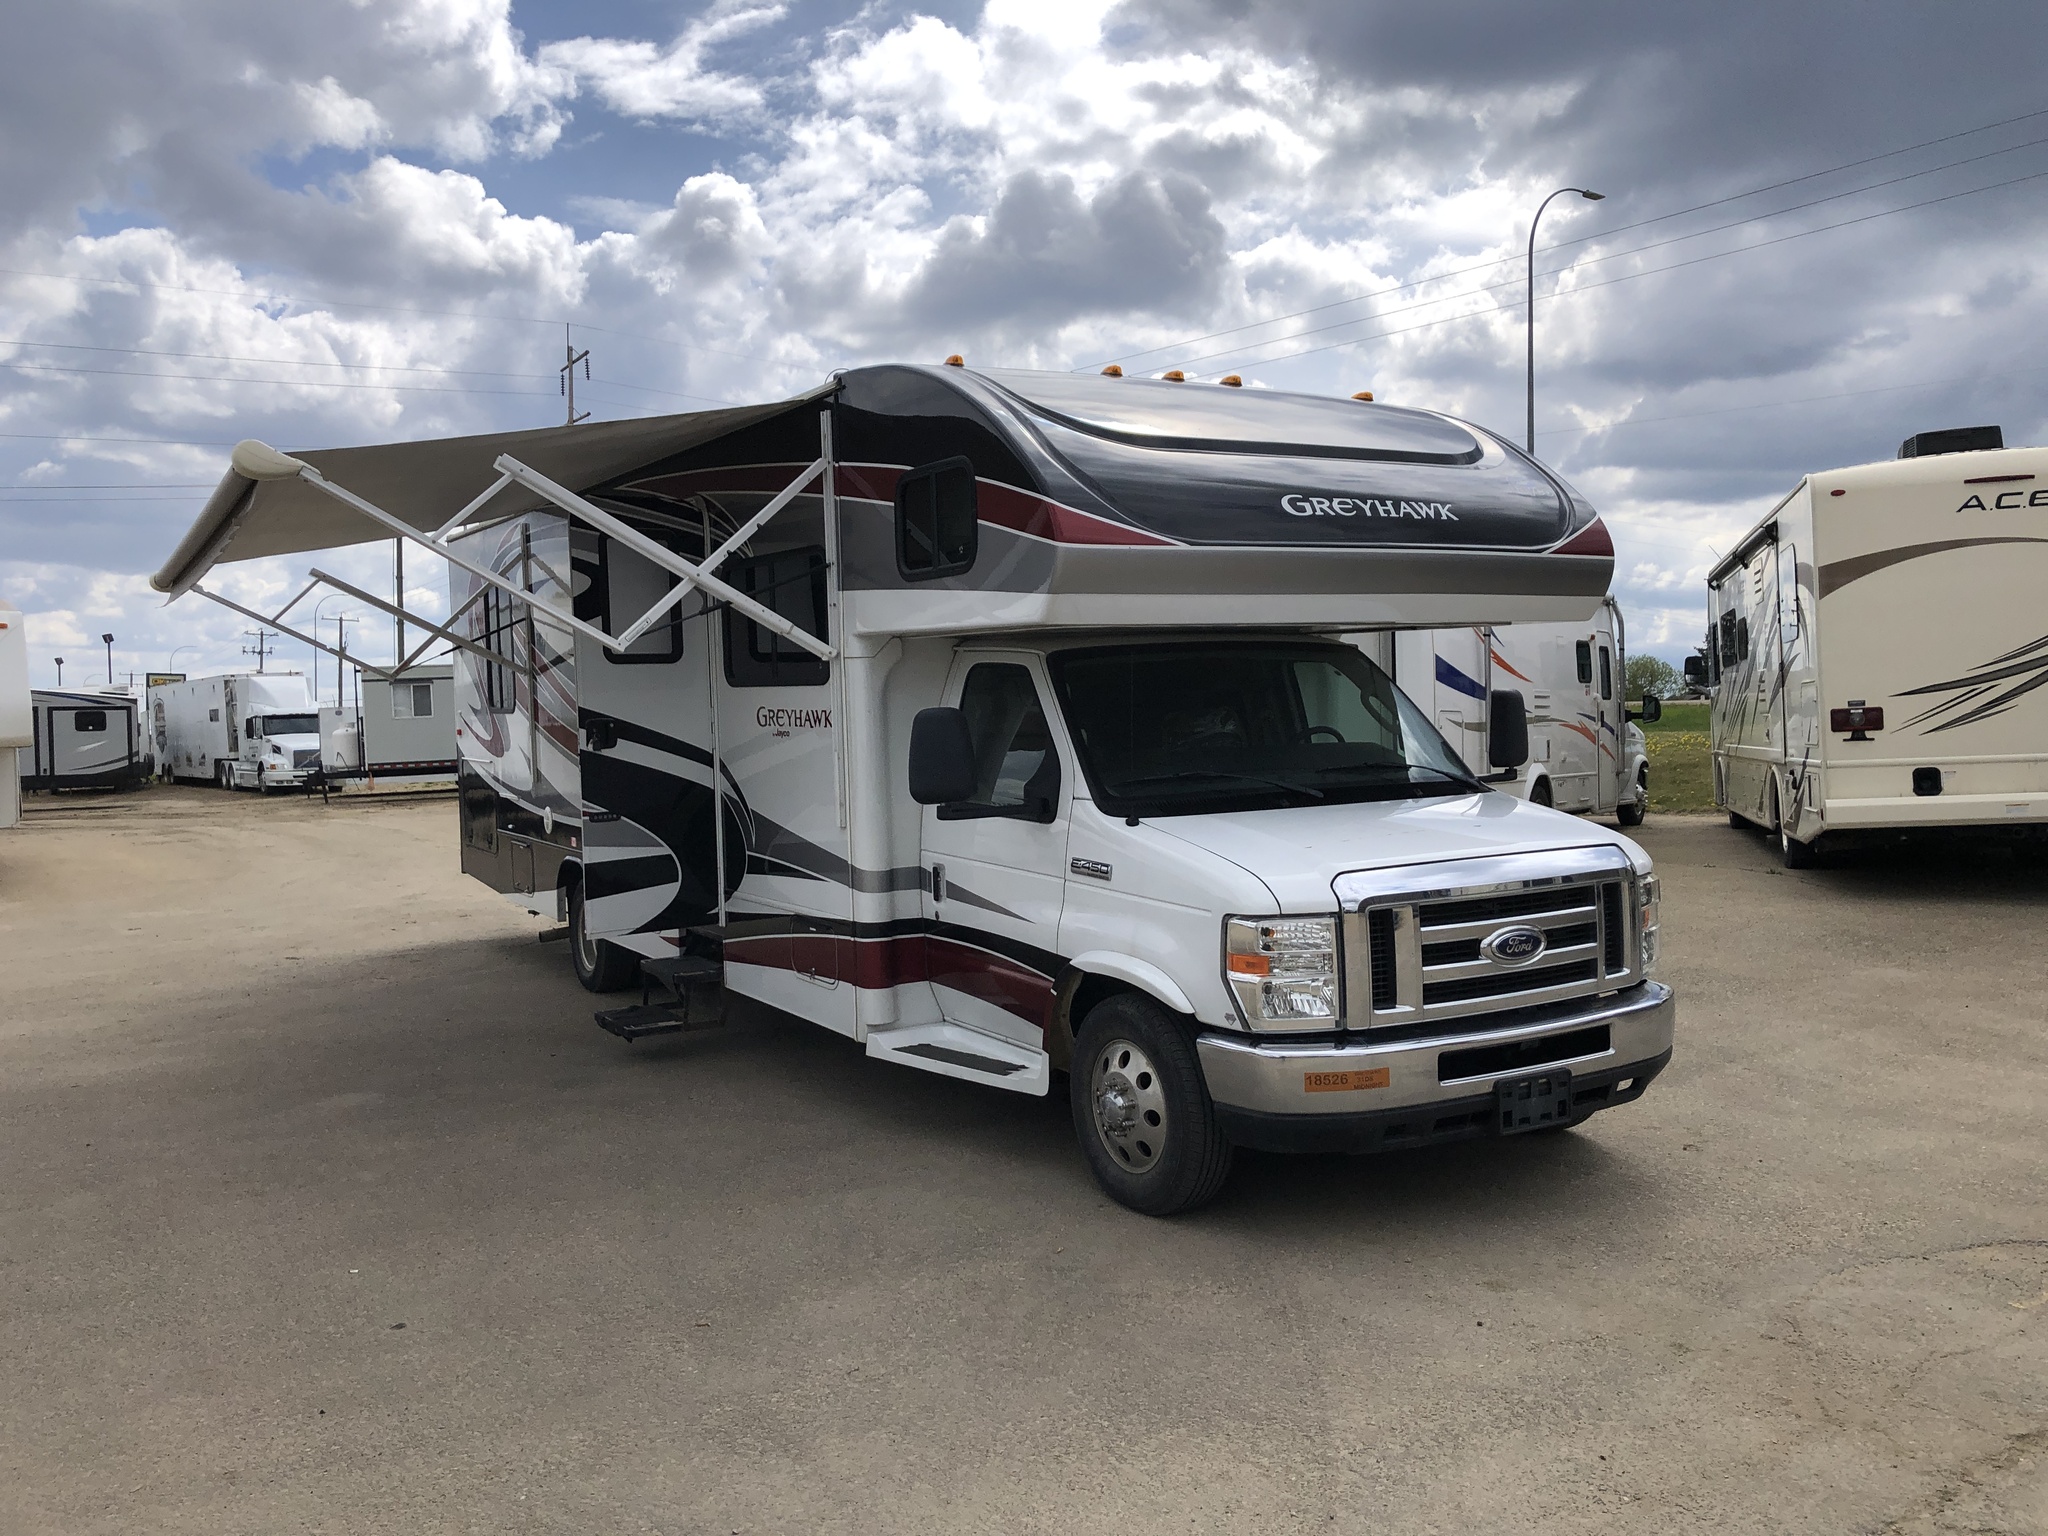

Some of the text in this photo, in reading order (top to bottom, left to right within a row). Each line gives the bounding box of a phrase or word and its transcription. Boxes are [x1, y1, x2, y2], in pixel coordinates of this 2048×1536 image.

[1280, 494, 1459, 521] GREYHAWK
[756, 706, 833, 729] GREYHAWK
[1506, 936, 1534, 953] Ford
[1306, 1074, 1349, 1086] 18526
